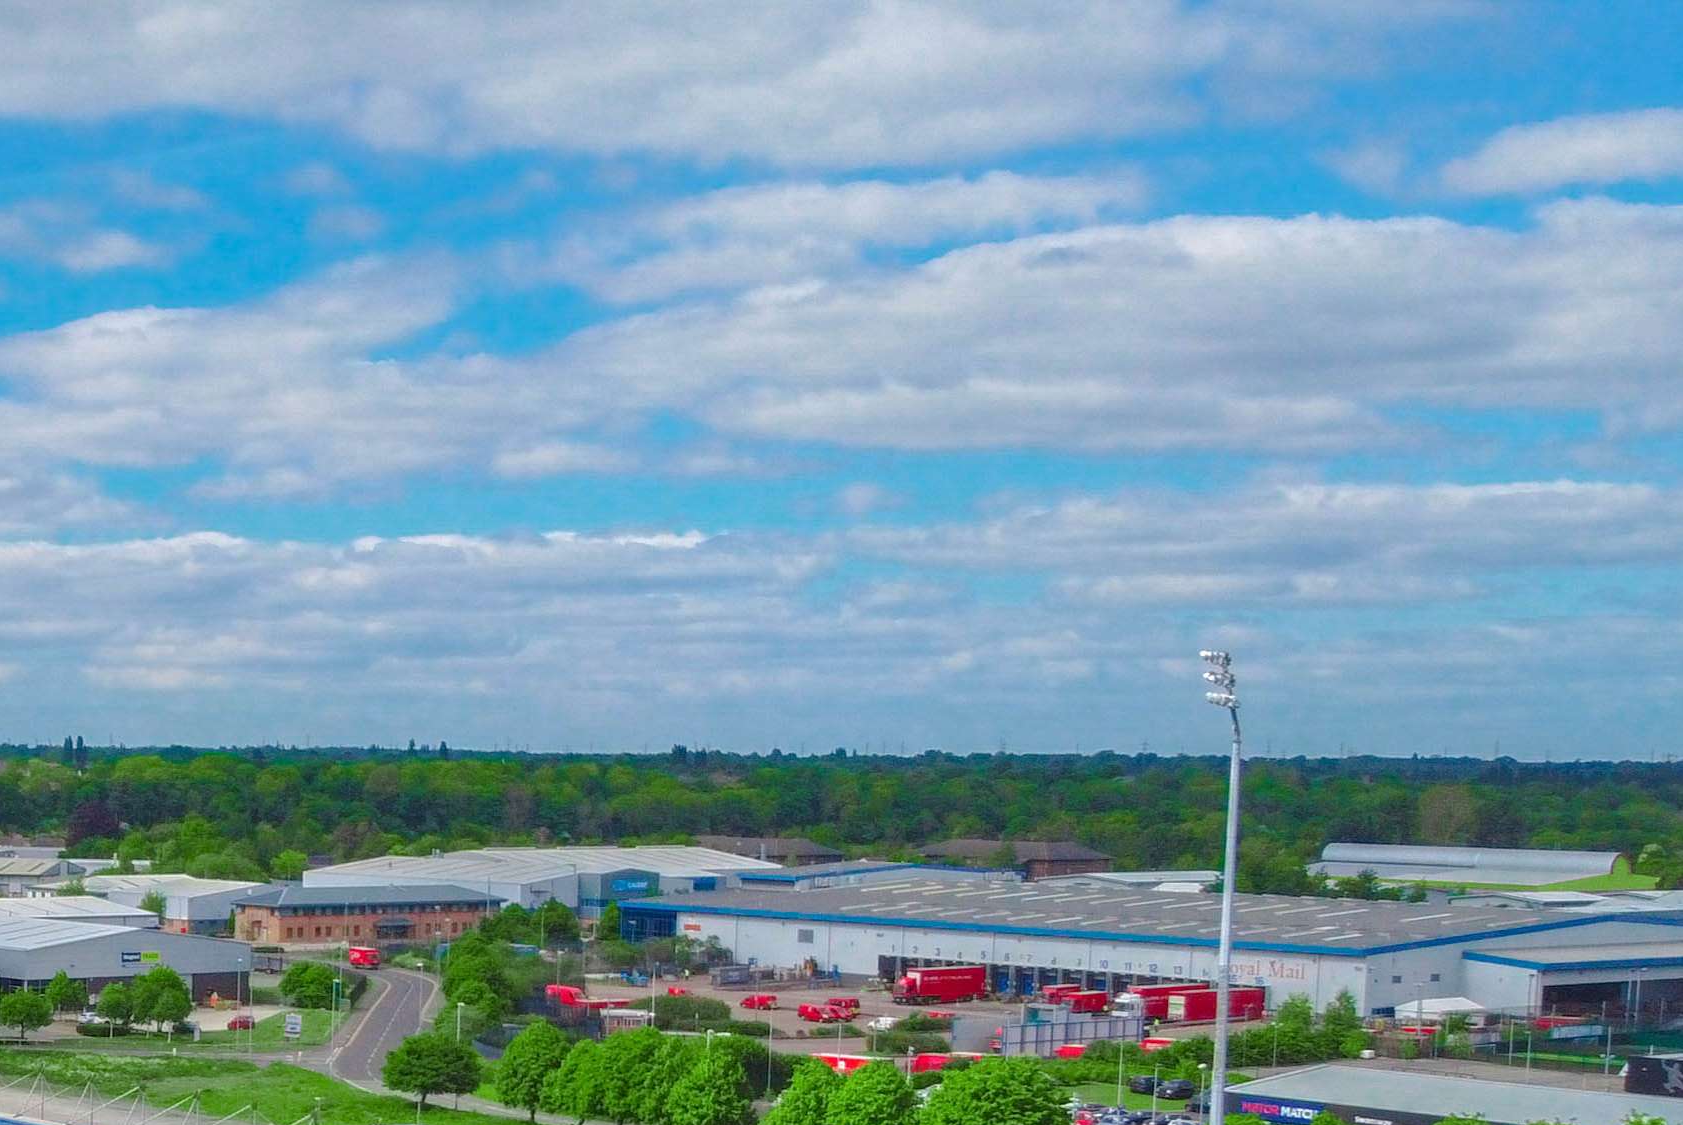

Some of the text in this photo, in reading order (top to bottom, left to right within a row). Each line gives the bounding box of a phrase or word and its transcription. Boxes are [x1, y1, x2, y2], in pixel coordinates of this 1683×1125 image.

[1149, 963, 1158, 973] 12
[1173, 965, 1182, 975] 13
[1227, 960, 1306, 980] oyal Mail
